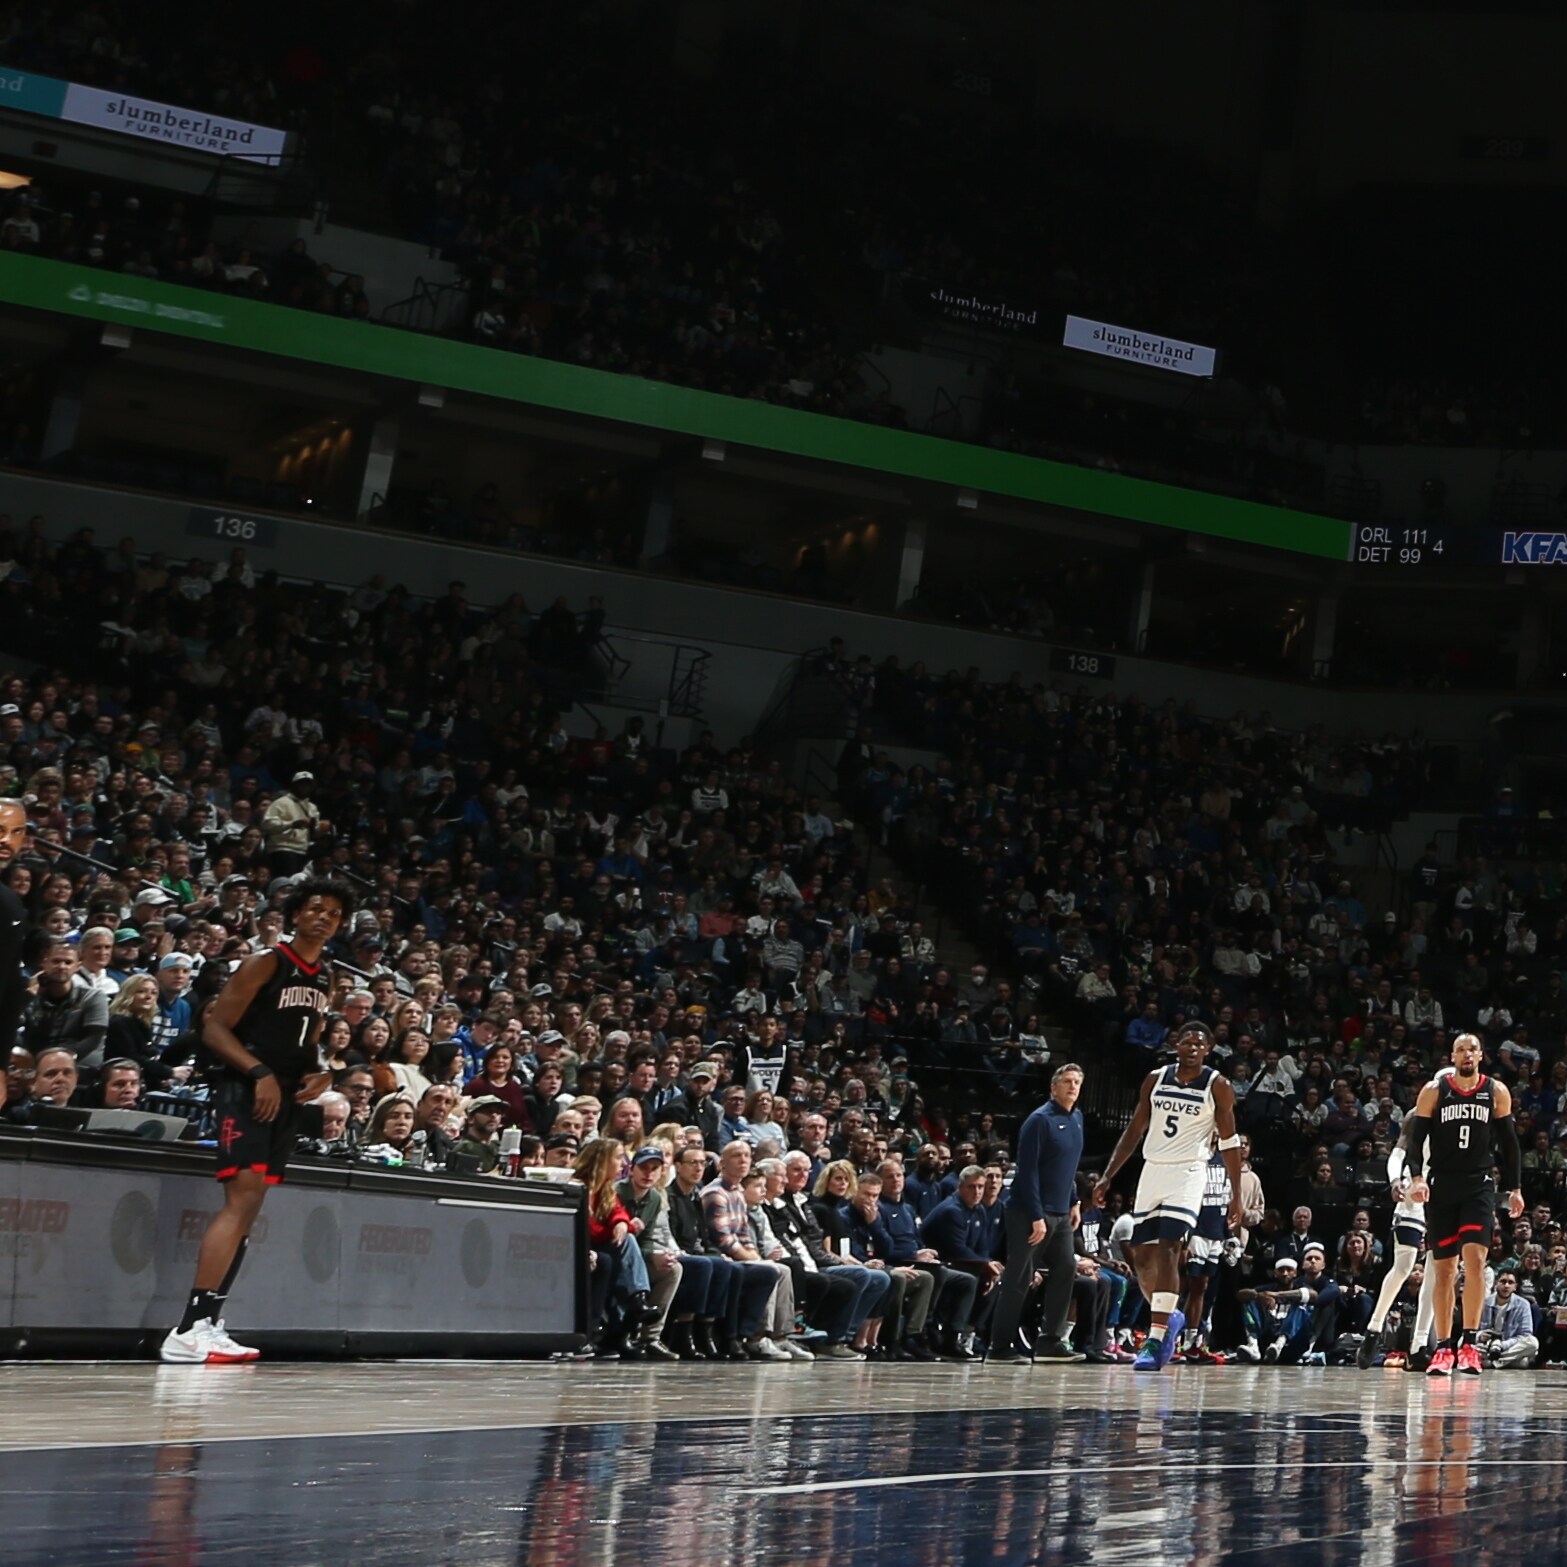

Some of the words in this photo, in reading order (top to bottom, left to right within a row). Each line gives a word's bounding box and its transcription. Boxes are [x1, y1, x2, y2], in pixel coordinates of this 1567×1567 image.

[106, 99, 255, 144] slumberland
[125, 120, 230, 151] FURNITURE
[1093, 326, 1195, 361] slumberland
[1107, 344, 1178, 368] FURNITURE
[213, 516, 256, 539] 136
[1360, 527, 1392, 543] ORL
[1402, 529, 1427, 544] 111
[1433, 540, 1443, 554] 4
[1359, 547, 1391, 562] DET
[1400, 549, 1421, 564] 99
[1068, 654, 1098, 674] 138
[299, 1015, 310, 1047] 1
[763, 1079, 772, 1091] 5
[1153, 1099, 1200, 1116] WOLVES
[1441, 1103, 1490, 1124] HOUSTON
[1164, 1115, 1179, 1138] 5
[1458, 1125, 1470, 1149] 9
